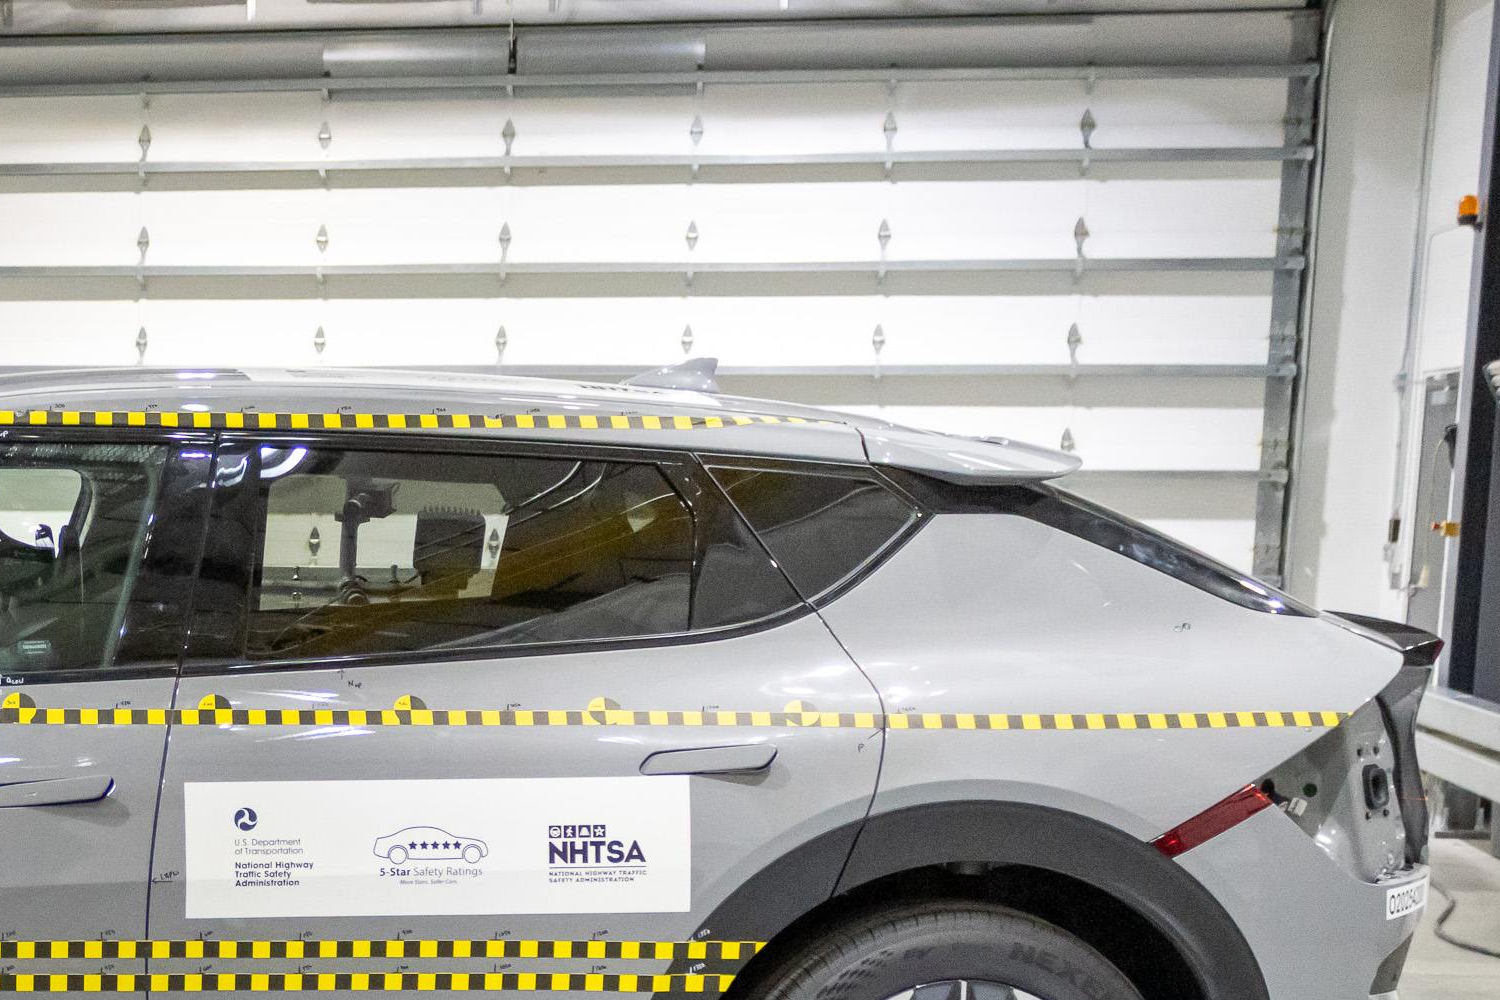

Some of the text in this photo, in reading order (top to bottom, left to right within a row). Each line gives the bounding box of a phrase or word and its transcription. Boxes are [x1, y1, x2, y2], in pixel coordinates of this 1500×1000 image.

[251, 838, 301, 848] Department
[234, 847, 304, 856] of Transportation
[548, 840, 647, 864] NHTSA
[235, 862, 314, 872] National Highway
[379, 866, 483, 878] 5-Star Safety Ratings
[235, 870, 292, 879] Traffic Safety
[235, 879, 300, 887] Administration
